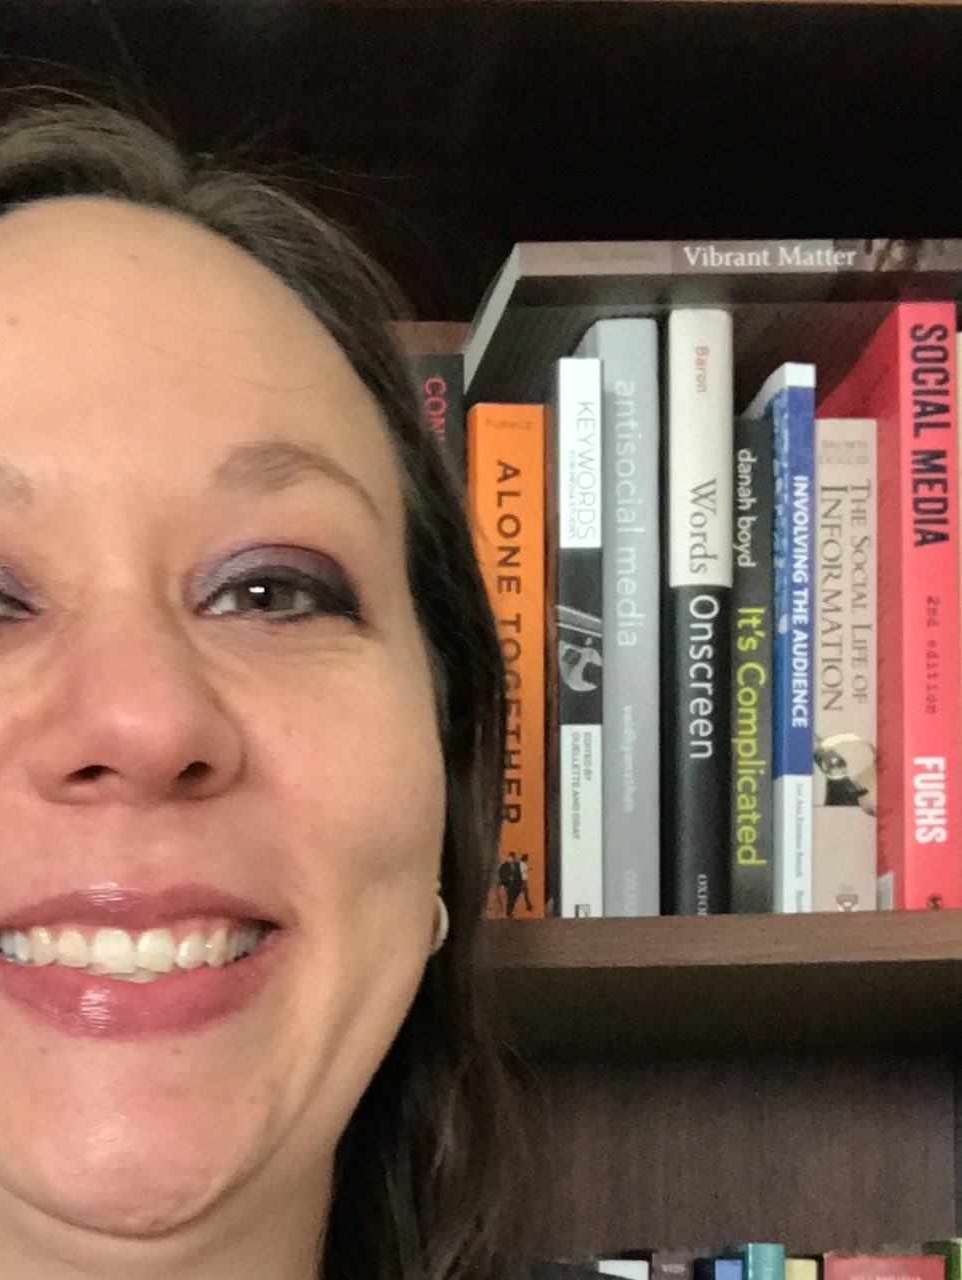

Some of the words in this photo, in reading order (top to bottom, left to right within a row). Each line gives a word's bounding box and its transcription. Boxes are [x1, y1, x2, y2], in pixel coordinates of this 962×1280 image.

[683, 245, 770, 268] Vibrant
[778, 246, 858, 268] Matter
[694, 345, 711, 394] Baron
[910, 323, 952, 438] SOCIAL
[575, 401, 598, 541] KEYWORDS
[614, 380, 647, 534] antisocial
[737, 447, 758, 511] danah
[911, 450, 952, 549] MEDIA
[496, 460, 523, 596] ALONE
[688, 478, 720, 575] Words
[733, 515, 758, 568] boyd
[791, 475, 810, 584] INVOLVING
[616, 546, 647, 647] media
[736, 606, 767, 652] It's
[792, 587, 809, 625] THE
[925, 595, 942, 628] 2nd
[688, 594, 720, 760] Onscreen
[791, 628, 809, 729] AUDIENCE
[924, 639, 941, 715] edition
[732, 661, 768, 865] Complicated
[912, 755, 949, 845] FUCHS
